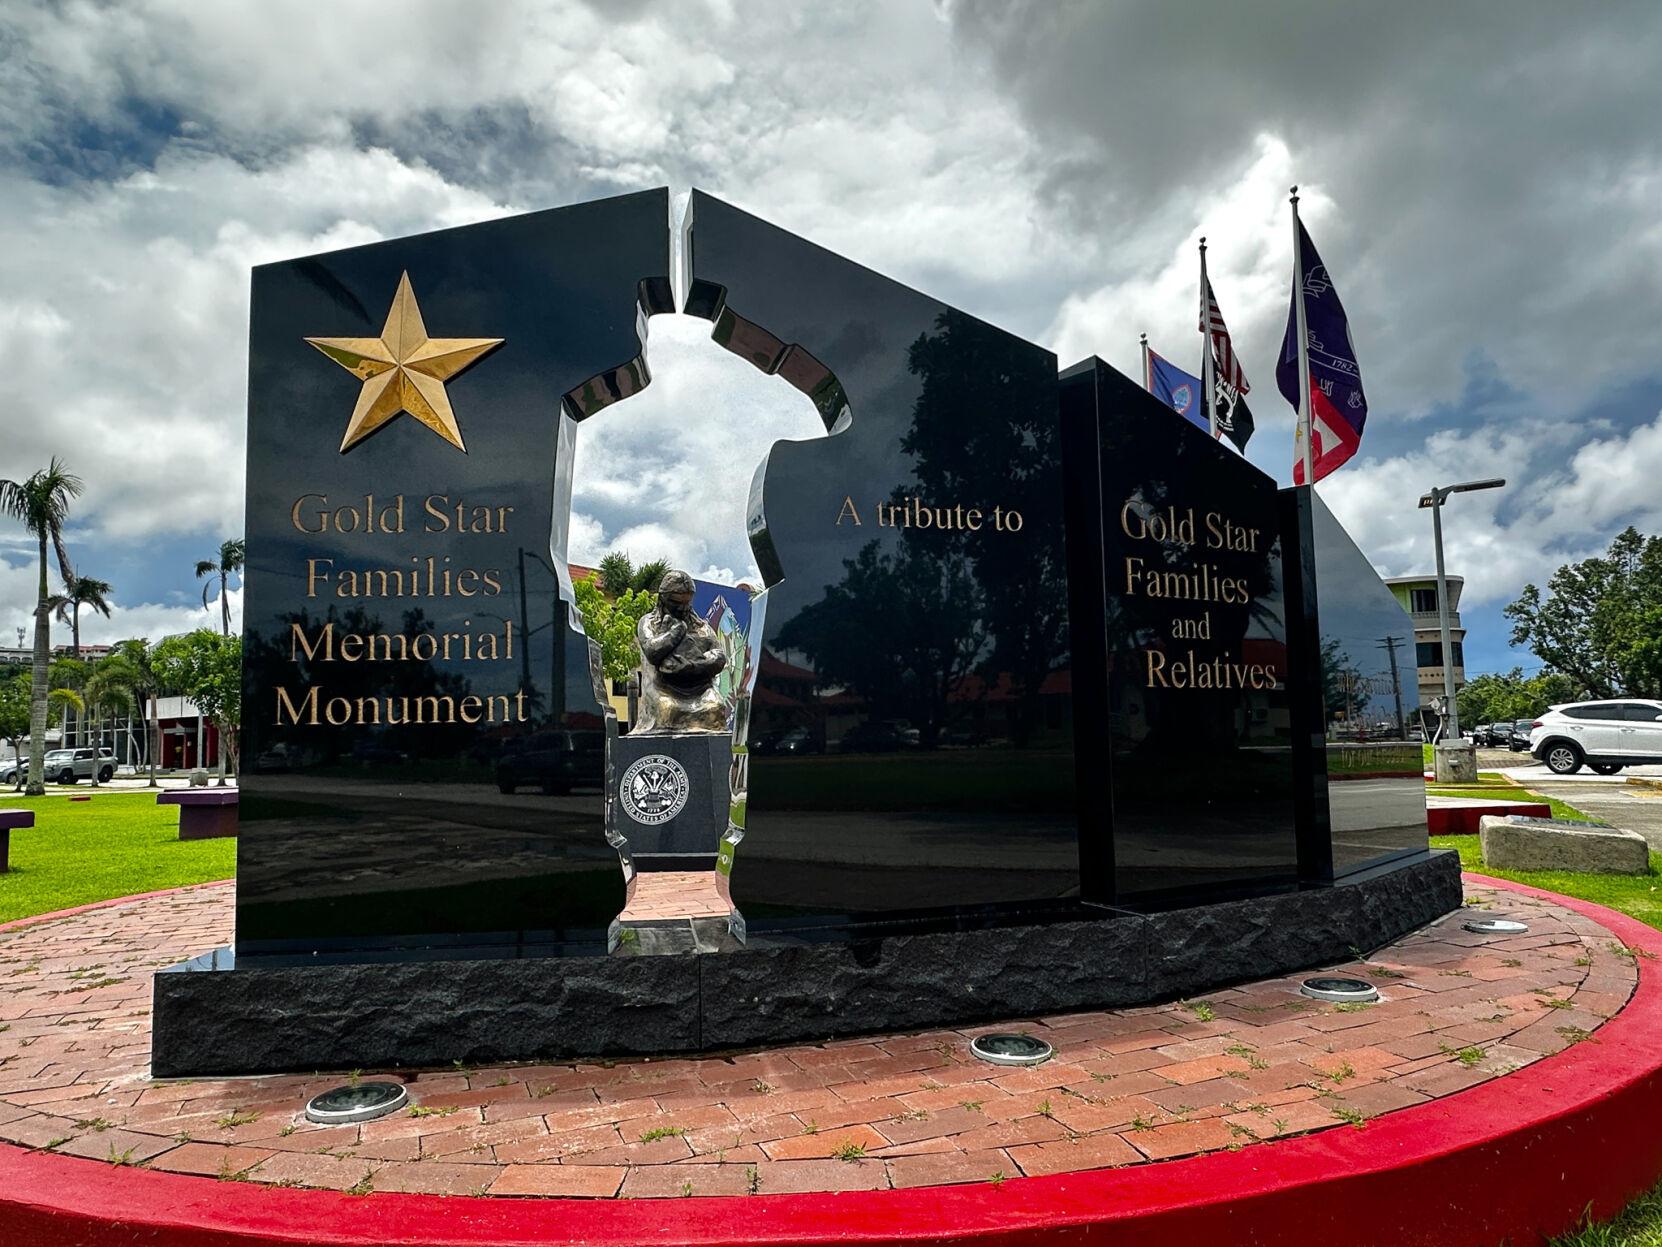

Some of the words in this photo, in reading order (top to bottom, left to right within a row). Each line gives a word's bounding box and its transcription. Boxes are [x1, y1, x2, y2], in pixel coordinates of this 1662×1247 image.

[1332, 359, 1353, 372] 1782
[291, 493, 405, 534] Gold
[424, 494, 514, 534] Star
[836, 495, 862, 526] A
[877, 496, 983, 530] tribute
[994, 504, 1023, 532] to
[1121, 501, 1196, 546] Gold
[1206, 512, 1260, 552] Star
[305, 555, 502, 598] Families
[1125, 557, 1249, 604] Families
[288, 619, 514, 663] Memorial
[1172, 611, 1210, 640] and
[1146, 650, 1277, 689] Relatives
[272, 684, 529, 726] Monument
